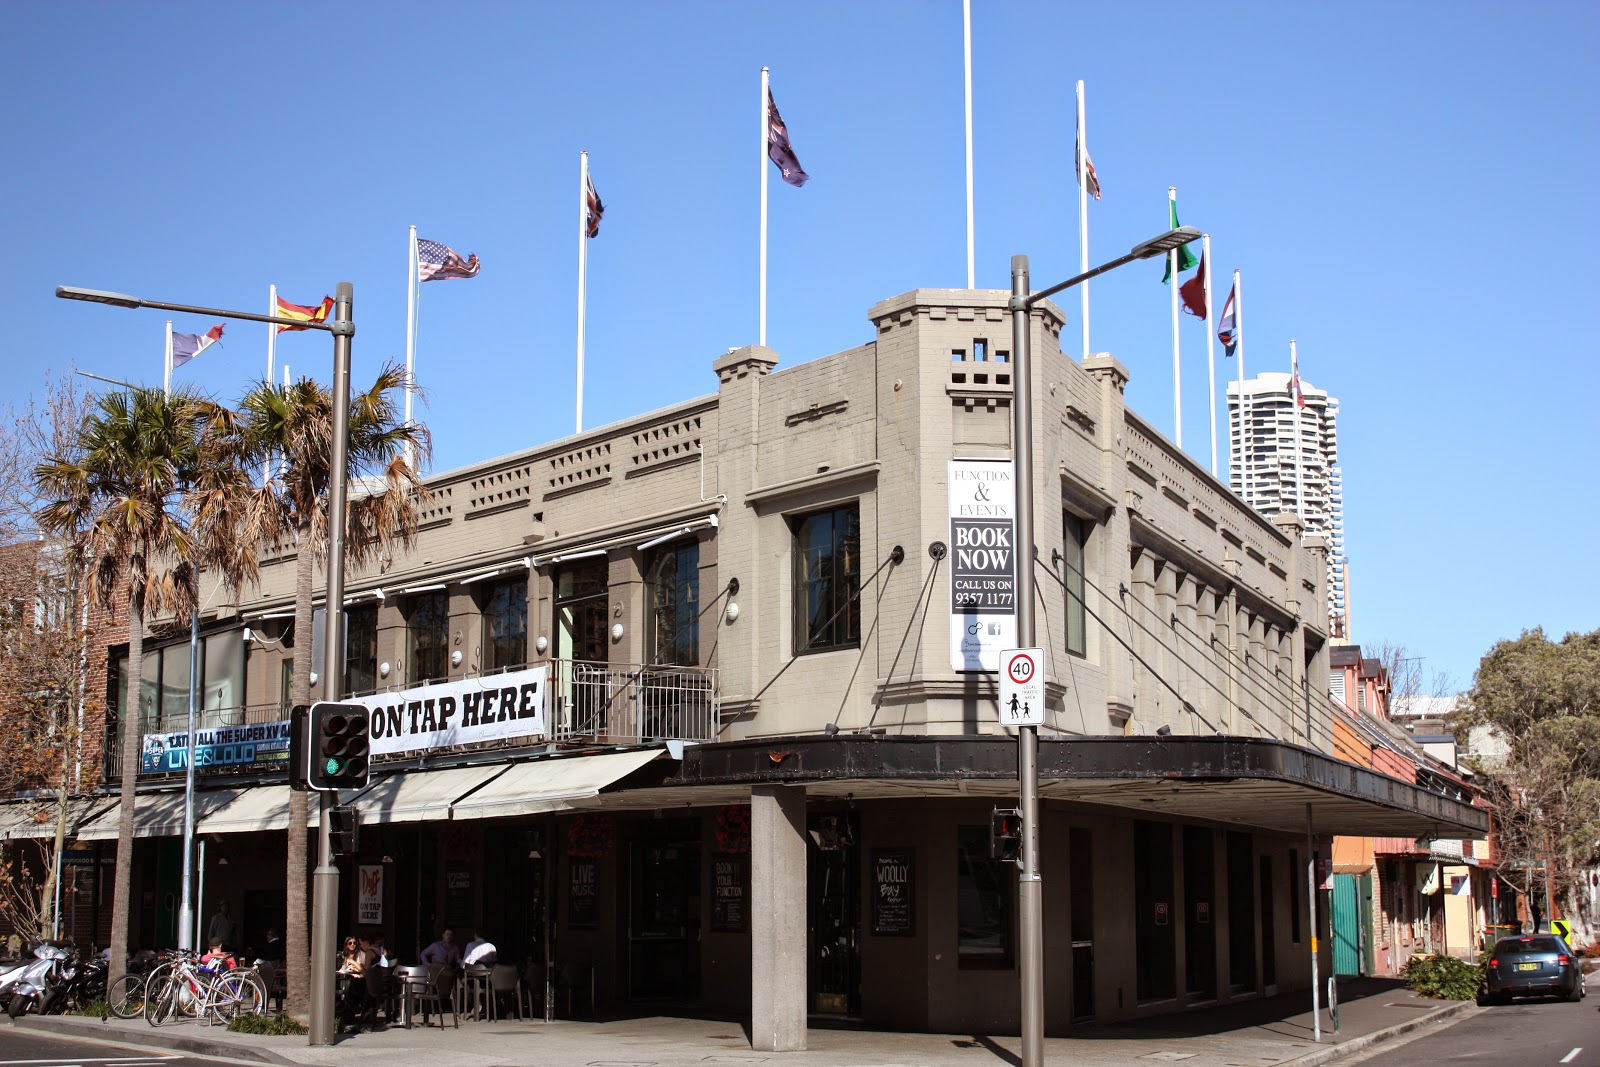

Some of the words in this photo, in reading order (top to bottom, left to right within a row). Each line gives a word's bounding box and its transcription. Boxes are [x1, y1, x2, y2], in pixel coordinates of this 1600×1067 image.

[955, 470, 1010, 482] FUNCTION
[974, 482, 991, 503] &
[960, 505, 1007, 516] EVENTS
[956, 527, 1010, 547] BOOK
[957, 549, 1010, 570] NOW
[955, 580, 982, 590] CALL
[984, 580, 996, 590] US
[998, 580, 1012, 590] ON
[955, 593, 984, 605] 9357
[987, 593, 1013, 605] 1177
[1013, 662, 1030, 676] 40
[371, 703, 404, 740] ON
[408, 696, 456, 735] TAP
[462, 682, 538, 727] HERE
[198, 731, 214, 746] ALL
[216, 729, 233, 744] THE
[234, 726, 265, 743] SUPER
[266, 725, 279, 740] XV
[572, 864, 595, 883] LIVE
[716, 863, 733, 874] BOOK
[876, 865, 909, 883] WOOLLY
[361, 868, 380, 897] Duff
[716, 875, 732, 886] YOUR
[1419, 873, 1435, 885] W
[572, 885, 595, 896] MUSIC
[716, 886, 743, 897] FUNCTION
[360, 903, 369, 911] ON
[369, 903, 381, 911] TAP
